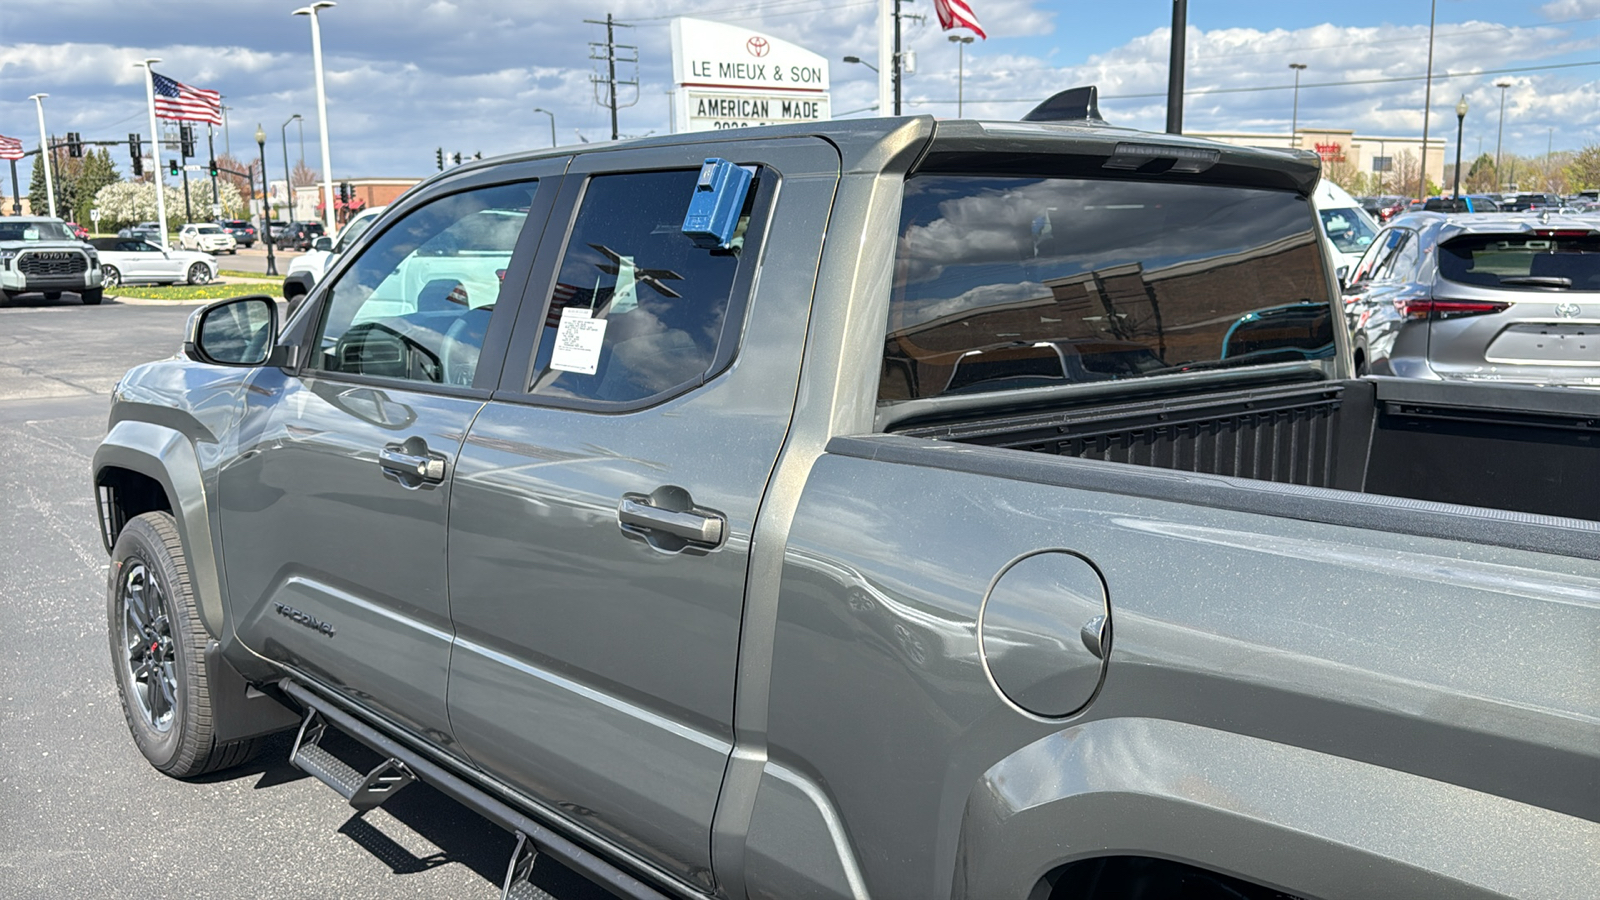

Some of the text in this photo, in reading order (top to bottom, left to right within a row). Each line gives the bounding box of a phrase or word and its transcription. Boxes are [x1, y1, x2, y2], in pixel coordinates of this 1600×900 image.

[692, 60, 822, 83] LE MIEUX & SON
[697, 98, 819, 119] AMERICAN MADE
[38, 252, 71, 260] TOYOTA
[273, 601, 336, 638] TACOMA
